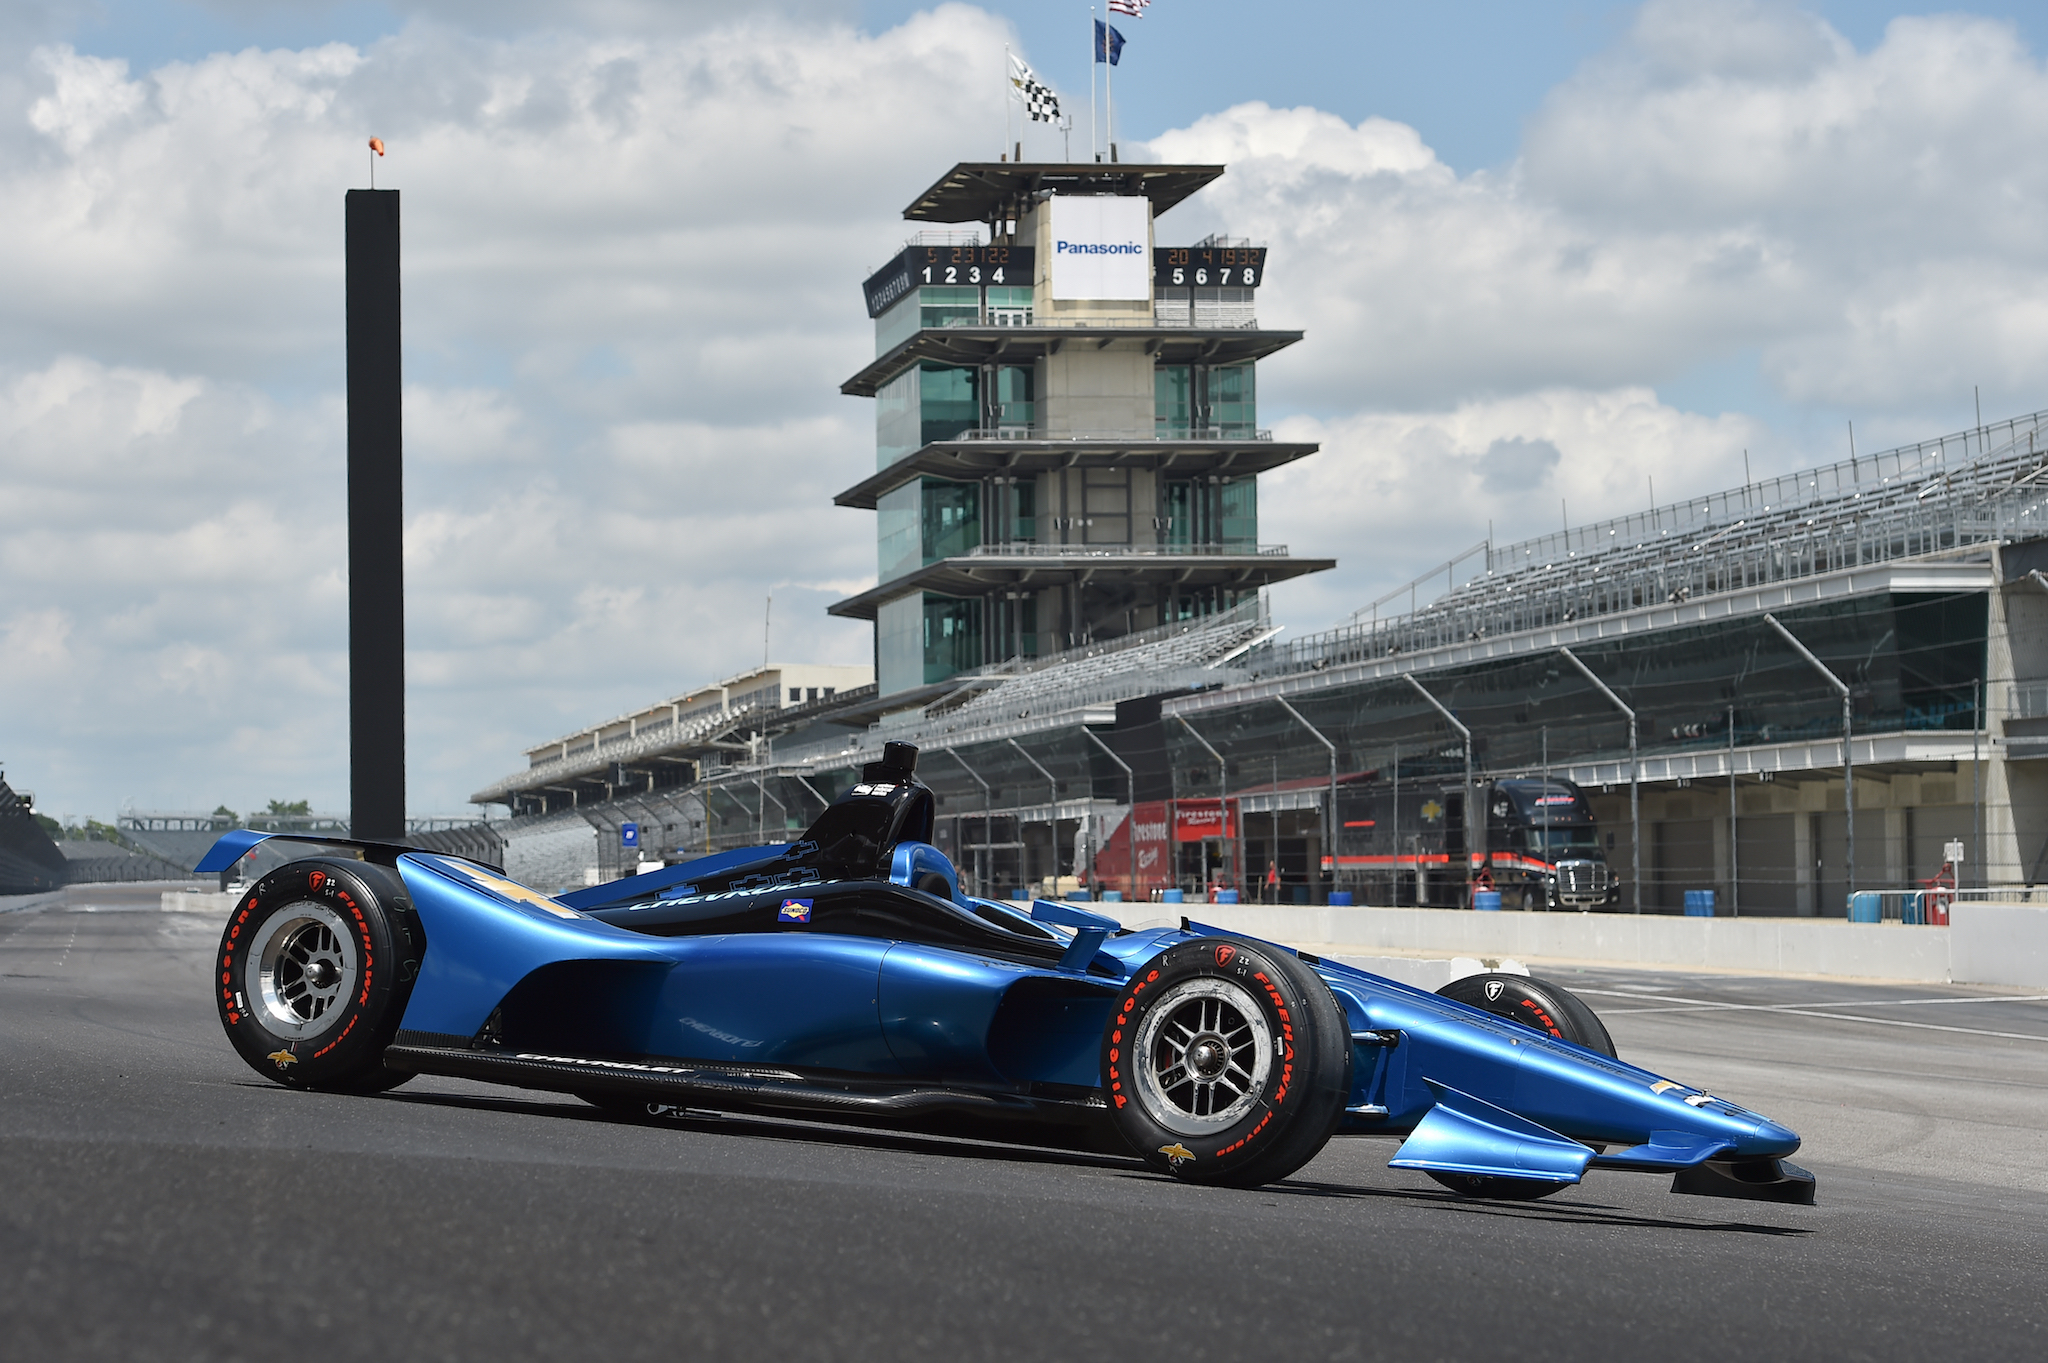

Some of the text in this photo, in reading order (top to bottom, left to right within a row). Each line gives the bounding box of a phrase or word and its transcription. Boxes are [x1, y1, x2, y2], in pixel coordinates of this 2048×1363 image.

[1057, 240, 1142, 254] Panasonic
[1168, 249, 1189, 265] 20
[1202, 249, 1212, 265] 4
[921, 266, 932, 284] 1
[944, 266, 957, 284] 2
[968, 266, 981, 284] 3
[991, 266, 1005, 284] 4
[1172, 267, 1185, 285] 5
[1195, 267, 1208, 285] 6
[1219, 267, 1232, 285] 7
[1242, 267, 1255, 285] 8
[338, 890, 373, 1007] FIREHAWK
[222, 898, 258, 1025] Firestone
[1162, 954, 1169, 966] R
[1238, 956, 1250, 966] 22
[1109, 969, 1160, 1109] Firestone
[1254, 971, 1294, 1104] FIREHAWK
[515, 1053, 695, 1072] CHEVROLET
[1525, 1037, 1624, 1076] PERFORMANCE
[1216, 1111, 1273, 1157] INDY500
